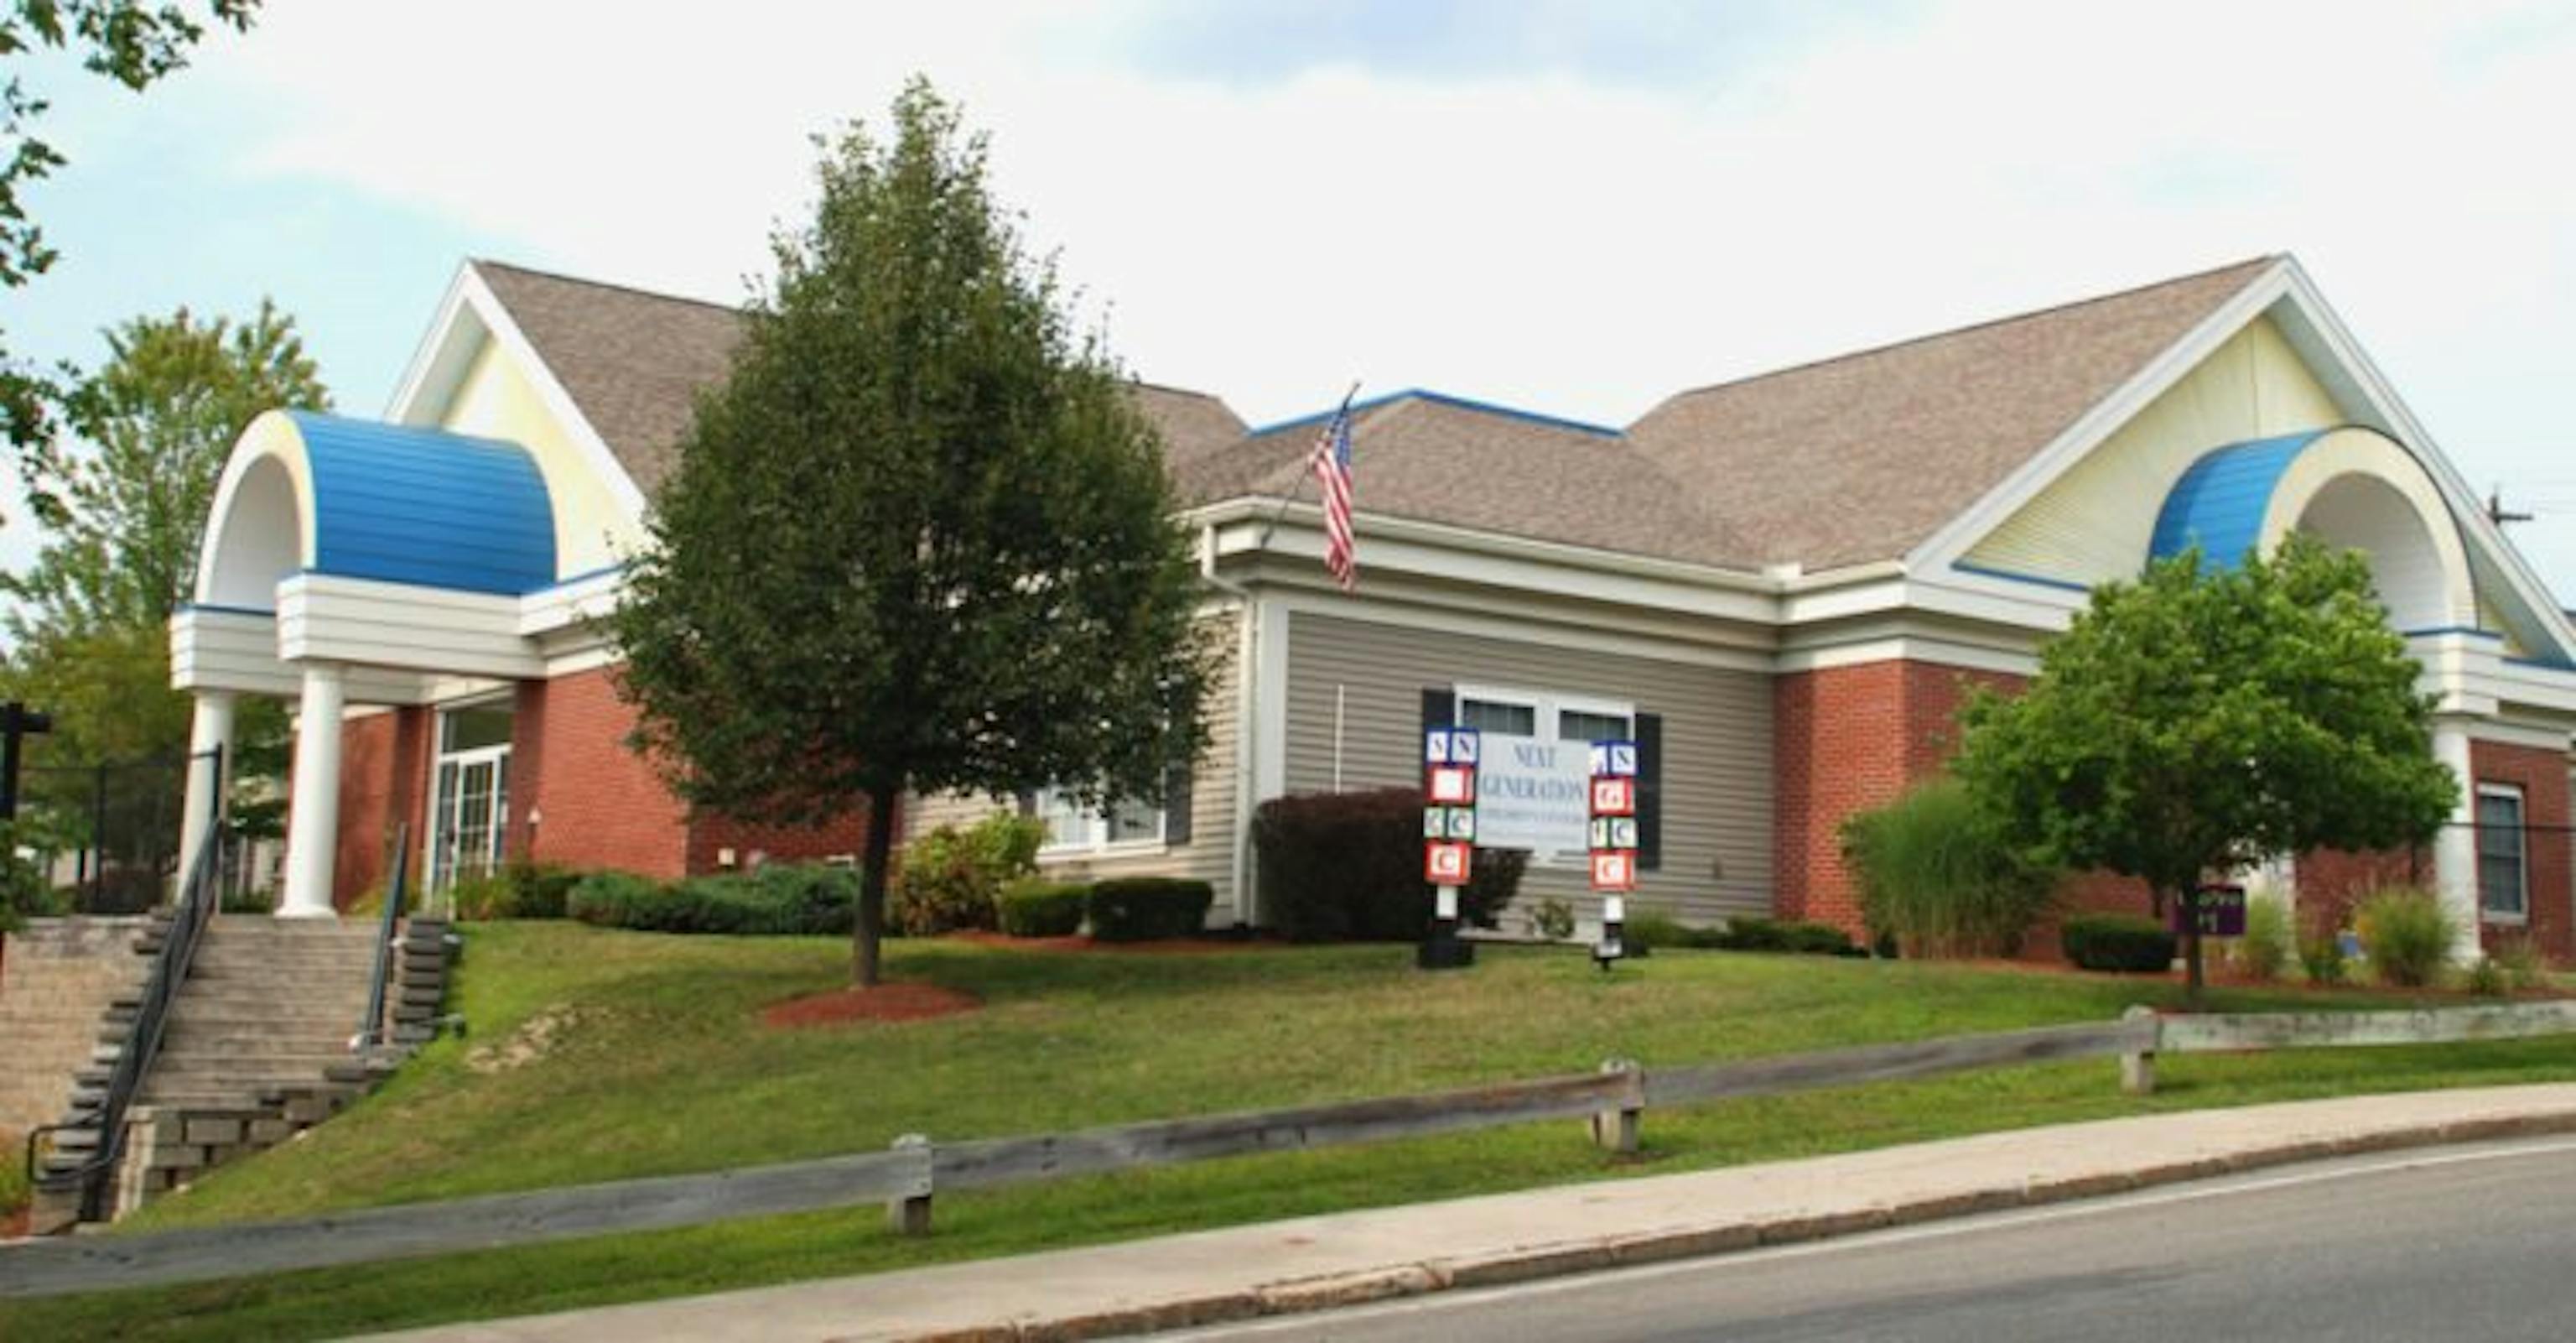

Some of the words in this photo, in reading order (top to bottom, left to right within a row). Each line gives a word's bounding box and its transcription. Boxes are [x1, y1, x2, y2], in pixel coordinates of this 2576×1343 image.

[1514, 743, 1556, 768] NEXT
[1616, 748, 1632, 767] N
[1481, 773, 1584, 802] GENERATION
[1452, 812, 1470, 833] C
[1437, 851, 1458, 872] C
